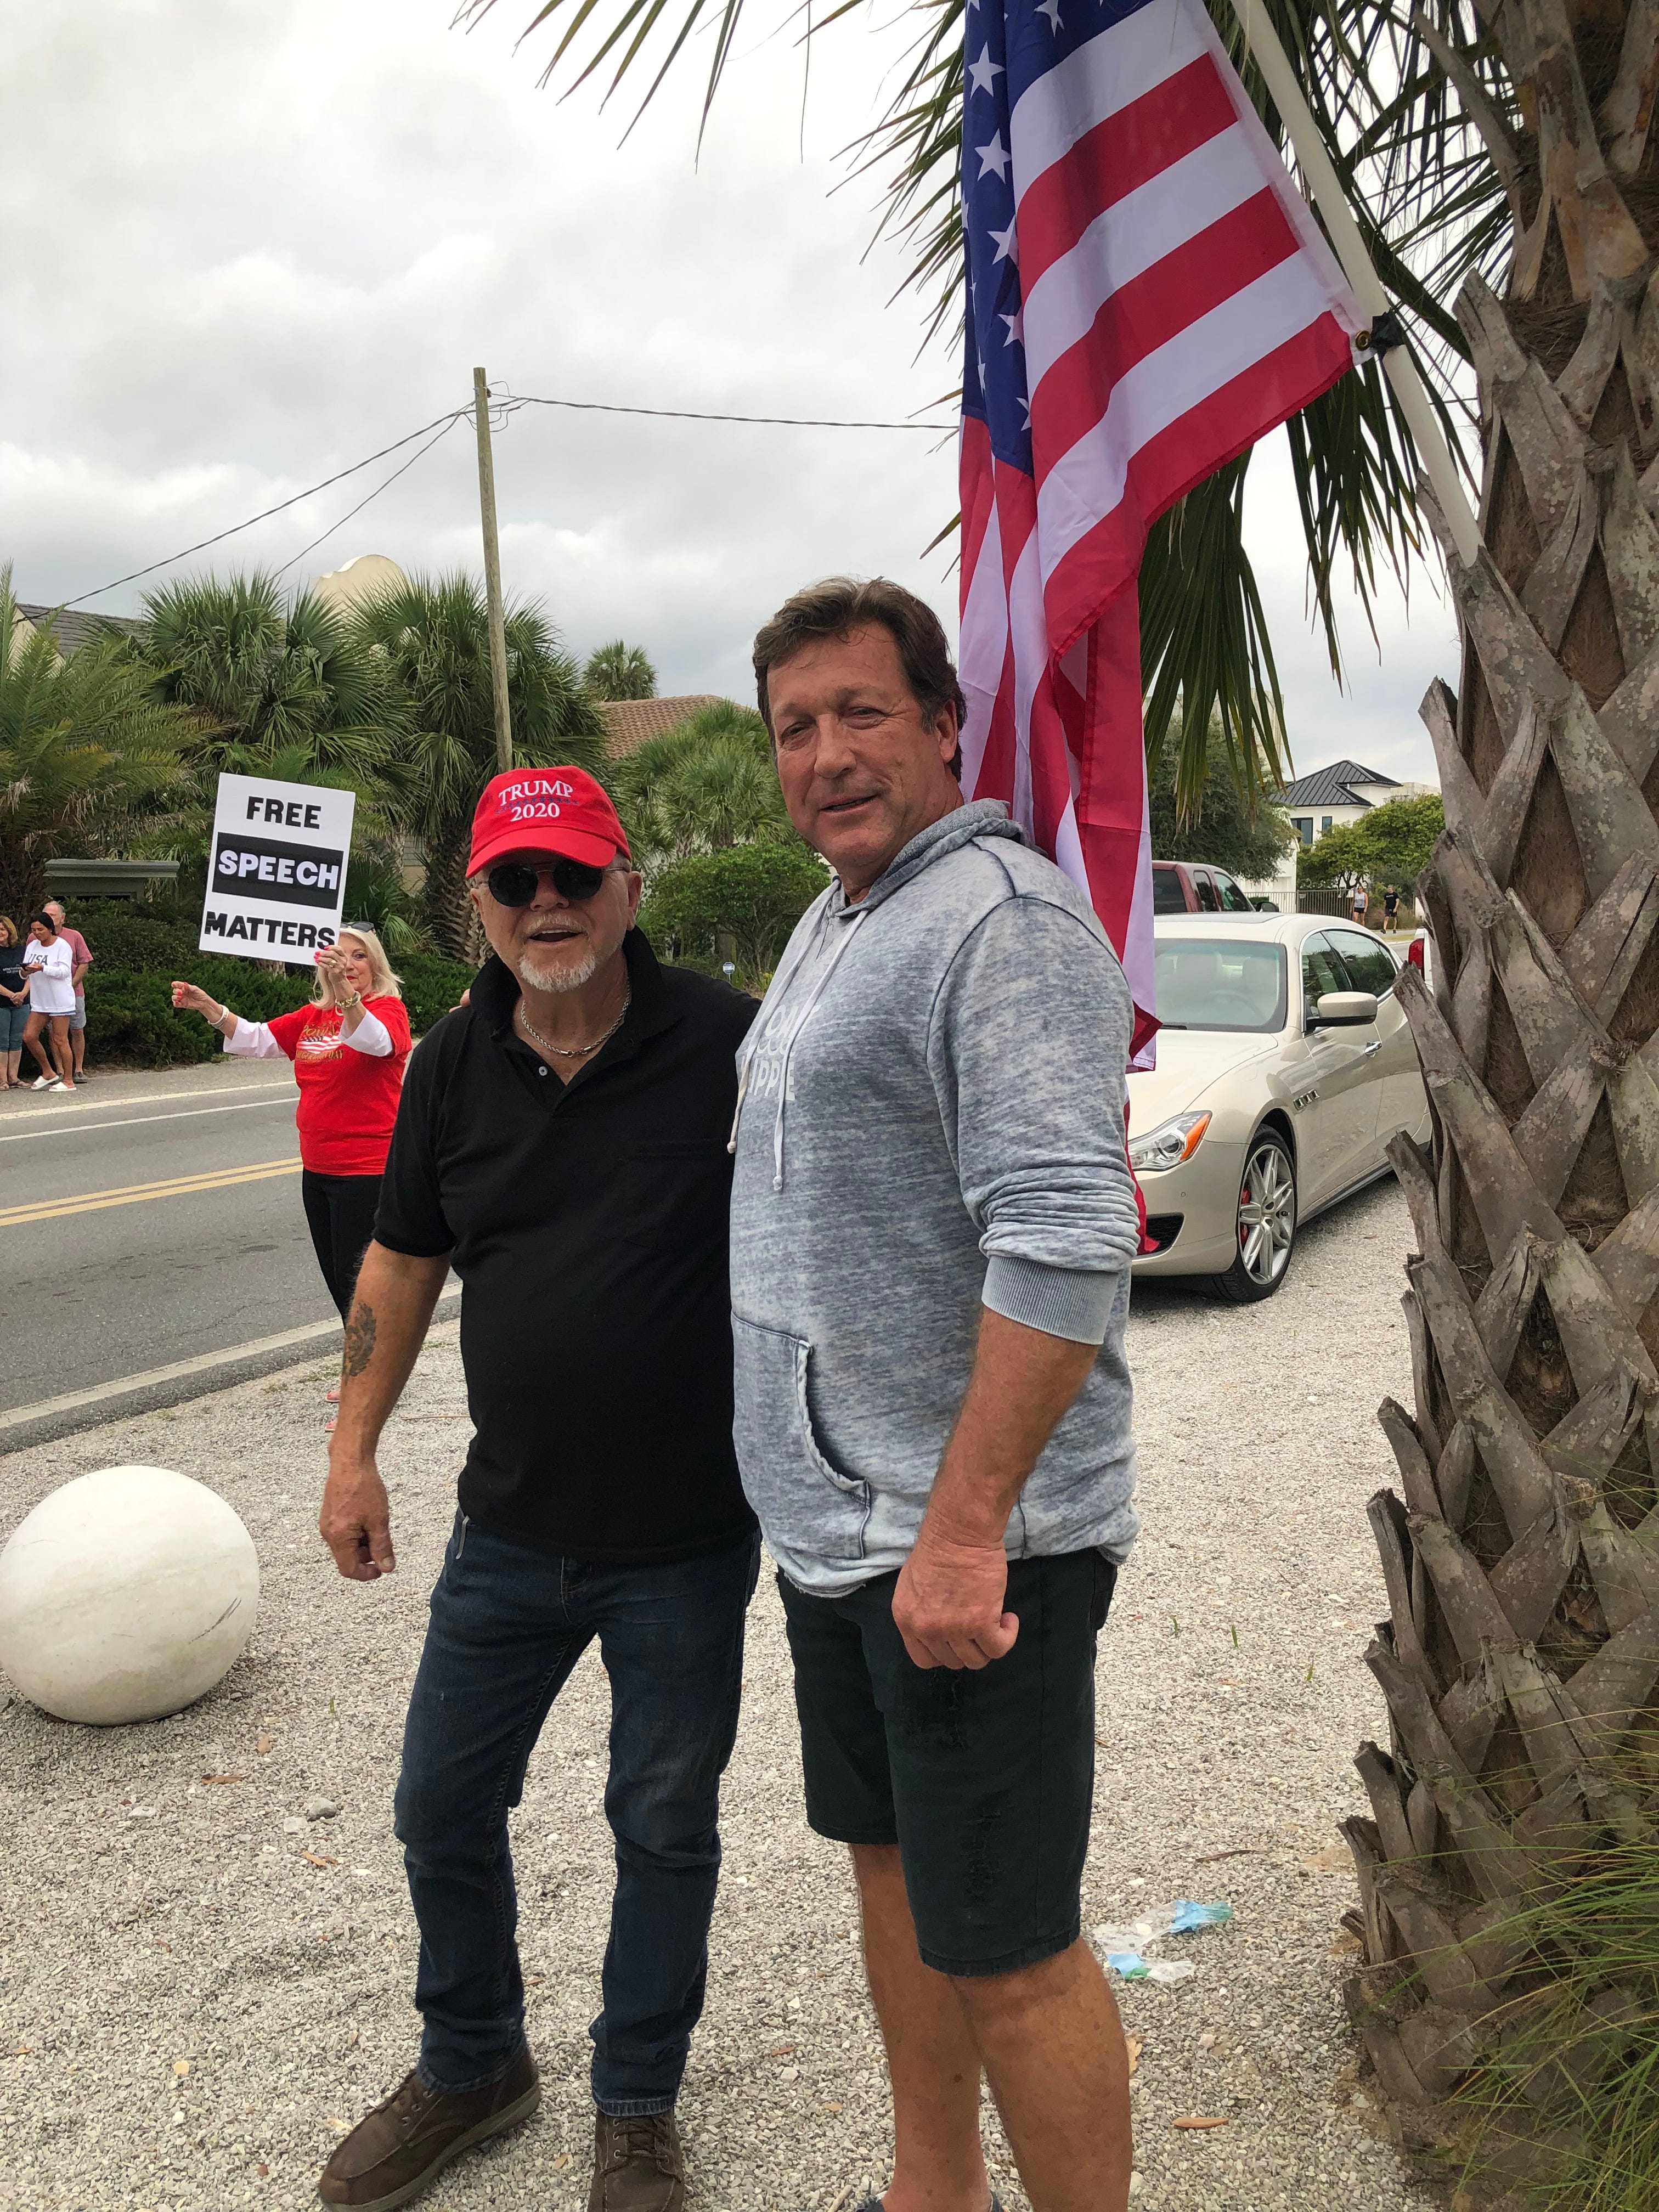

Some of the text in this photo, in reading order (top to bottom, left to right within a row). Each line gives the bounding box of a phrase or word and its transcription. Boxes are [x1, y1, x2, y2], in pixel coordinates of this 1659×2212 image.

[499, 780, 574, 806] TRUMP
[246, 796, 321, 829] FREE
[510, 803, 560, 822] 2020
[218, 850, 339, 890] SPEECH
[204, 911, 335, 950] MATTERS
[28, 953, 48, 966] USA
